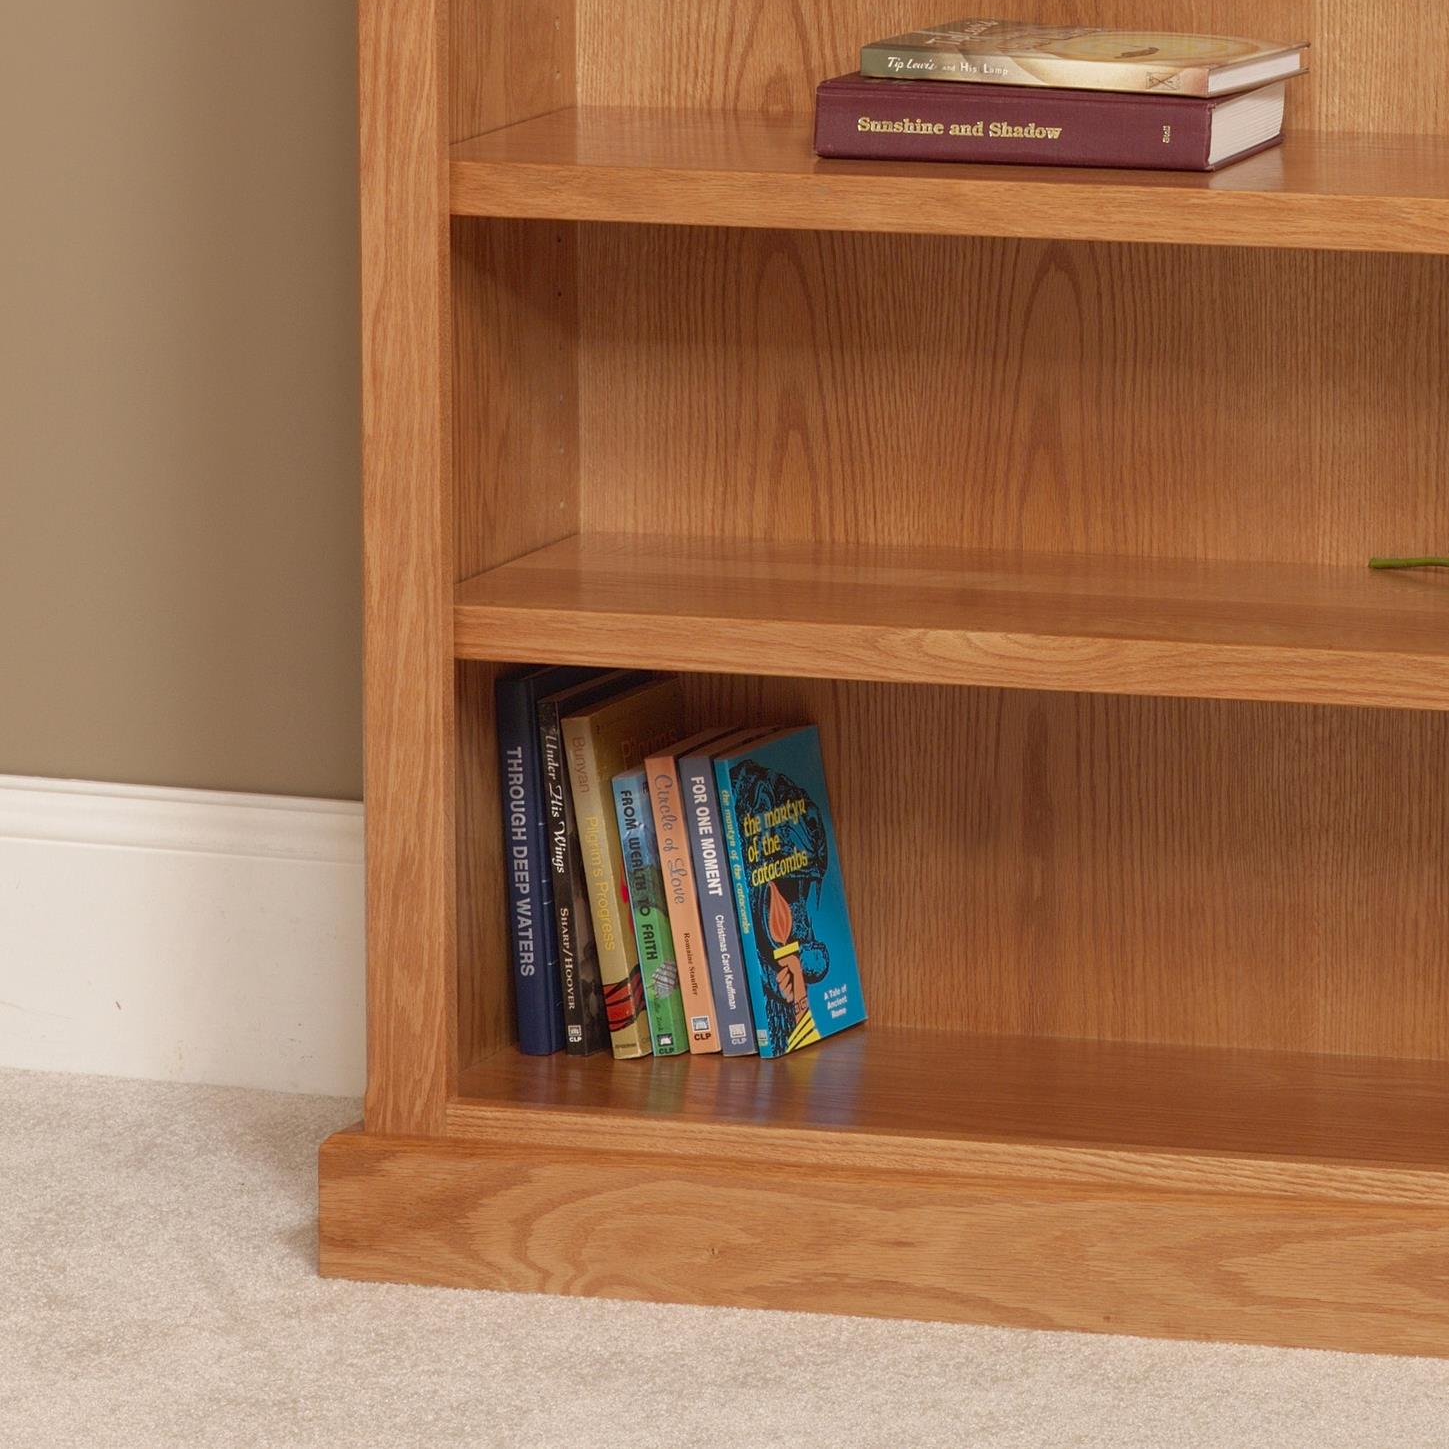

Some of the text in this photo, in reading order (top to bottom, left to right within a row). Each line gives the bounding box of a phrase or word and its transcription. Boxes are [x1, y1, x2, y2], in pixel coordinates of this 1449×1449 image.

[887, 56, 905, 72] Tip
[906, 58, 937, 71] Lewis
[960, 62, 977, 73] His
[983, 63, 1009, 77] Lamp
[857, 116, 1063, 140] Sunshine and Shadow
[572, 736, 591, 793] Bunyan
[544, 731, 567, 874] Under His Wings
[743, 798, 807, 837] the martyr
[654, 774, 689, 905] Circle of Love
[690, 776, 723, 897] FOR ONE MOMENT
[729, 850, 739, 862] of
[747, 831, 781, 863] of the
[506, 746, 535, 977] THROUGH DEEP WATERS
[620, 790, 659, 961] FROM WEALTH TO FAITH
[733, 865, 742, 880] the
[751, 847, 809, 888] catacombs
[585, 816, 616, 951] Pilgrim's Progress
[737, 883, 751, 935] catacombs
[683, 932, 699, 996] Romaine Stauffer
[714, 914, 737, 1010] Christmas Carol Kauffman
[824, 984, 848, 1001] A Tale of
[827, 997, 848, 1010] Ancient
[658, 1047, 675, 1055] CLP
[694, 1032, 712, 1041] CLP
[731, 1037, 747, 1046] CLP
